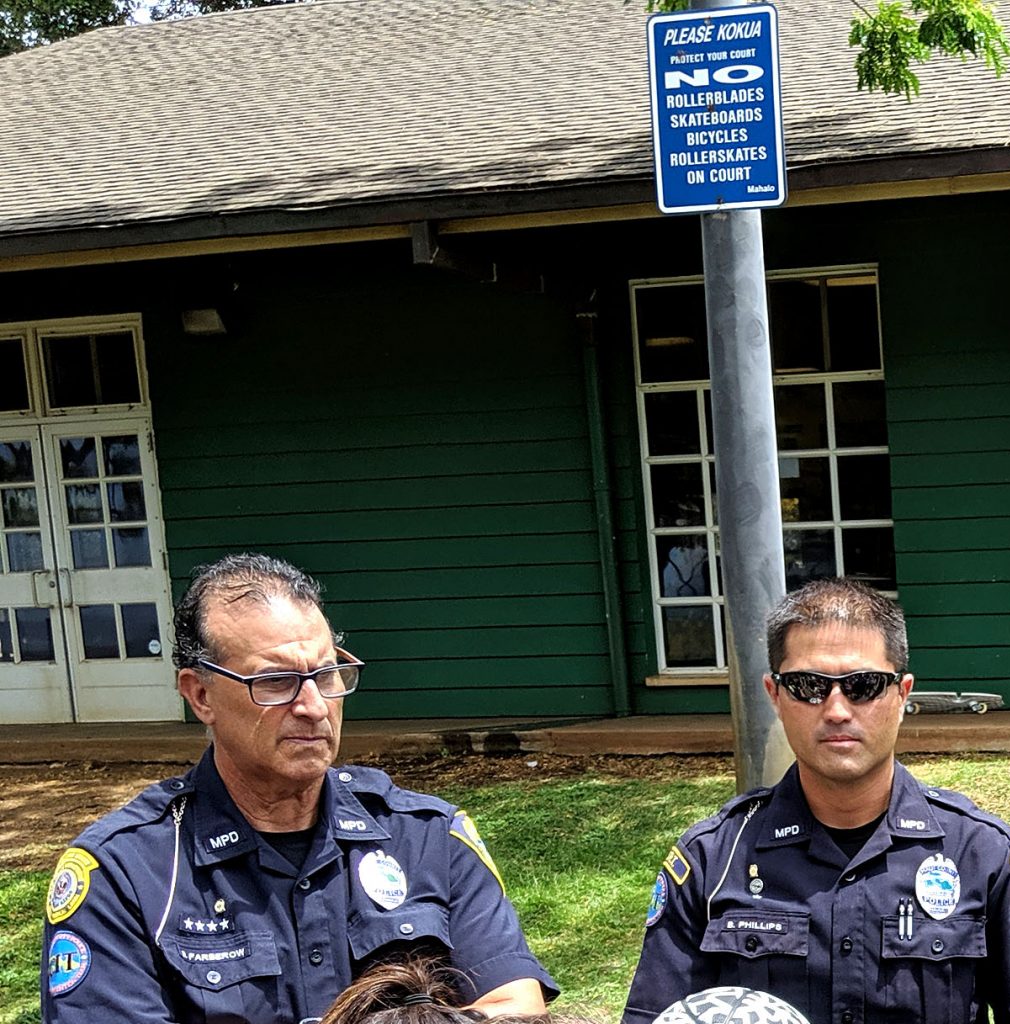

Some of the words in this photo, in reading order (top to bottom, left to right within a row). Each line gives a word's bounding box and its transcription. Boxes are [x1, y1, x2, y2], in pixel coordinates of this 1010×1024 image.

[664, 25, 714, 46] PLEASE
[717, 20, 762, 42] KOKUA
[670, 53, 704, 65] PROTECT
[707, 51, 727, 62] YOUR
[730, 48, 756, 60] COURT
[664, 64, 764, 89] NO
[666, 87, 764, 109] ROLLERBLADES
[670, 108, 763, 128] SKATEBOARDS
[686, 128, 748, 146] BICYCLES
[670, 146, 767, 167] ROLLERSKATES
[687, 170, 705, 184] ON
[710, 166, 752, 183] COURT
[747, 184, 775, 193] Mahalo
[338, 819, 367, 831] MPD
[774, 825, 800, 838] MPD
[900, 818, 926, 830] MPD
[209, 830, 240, 850] MPD
[738, 920, 783, 931] PHILLIPS
